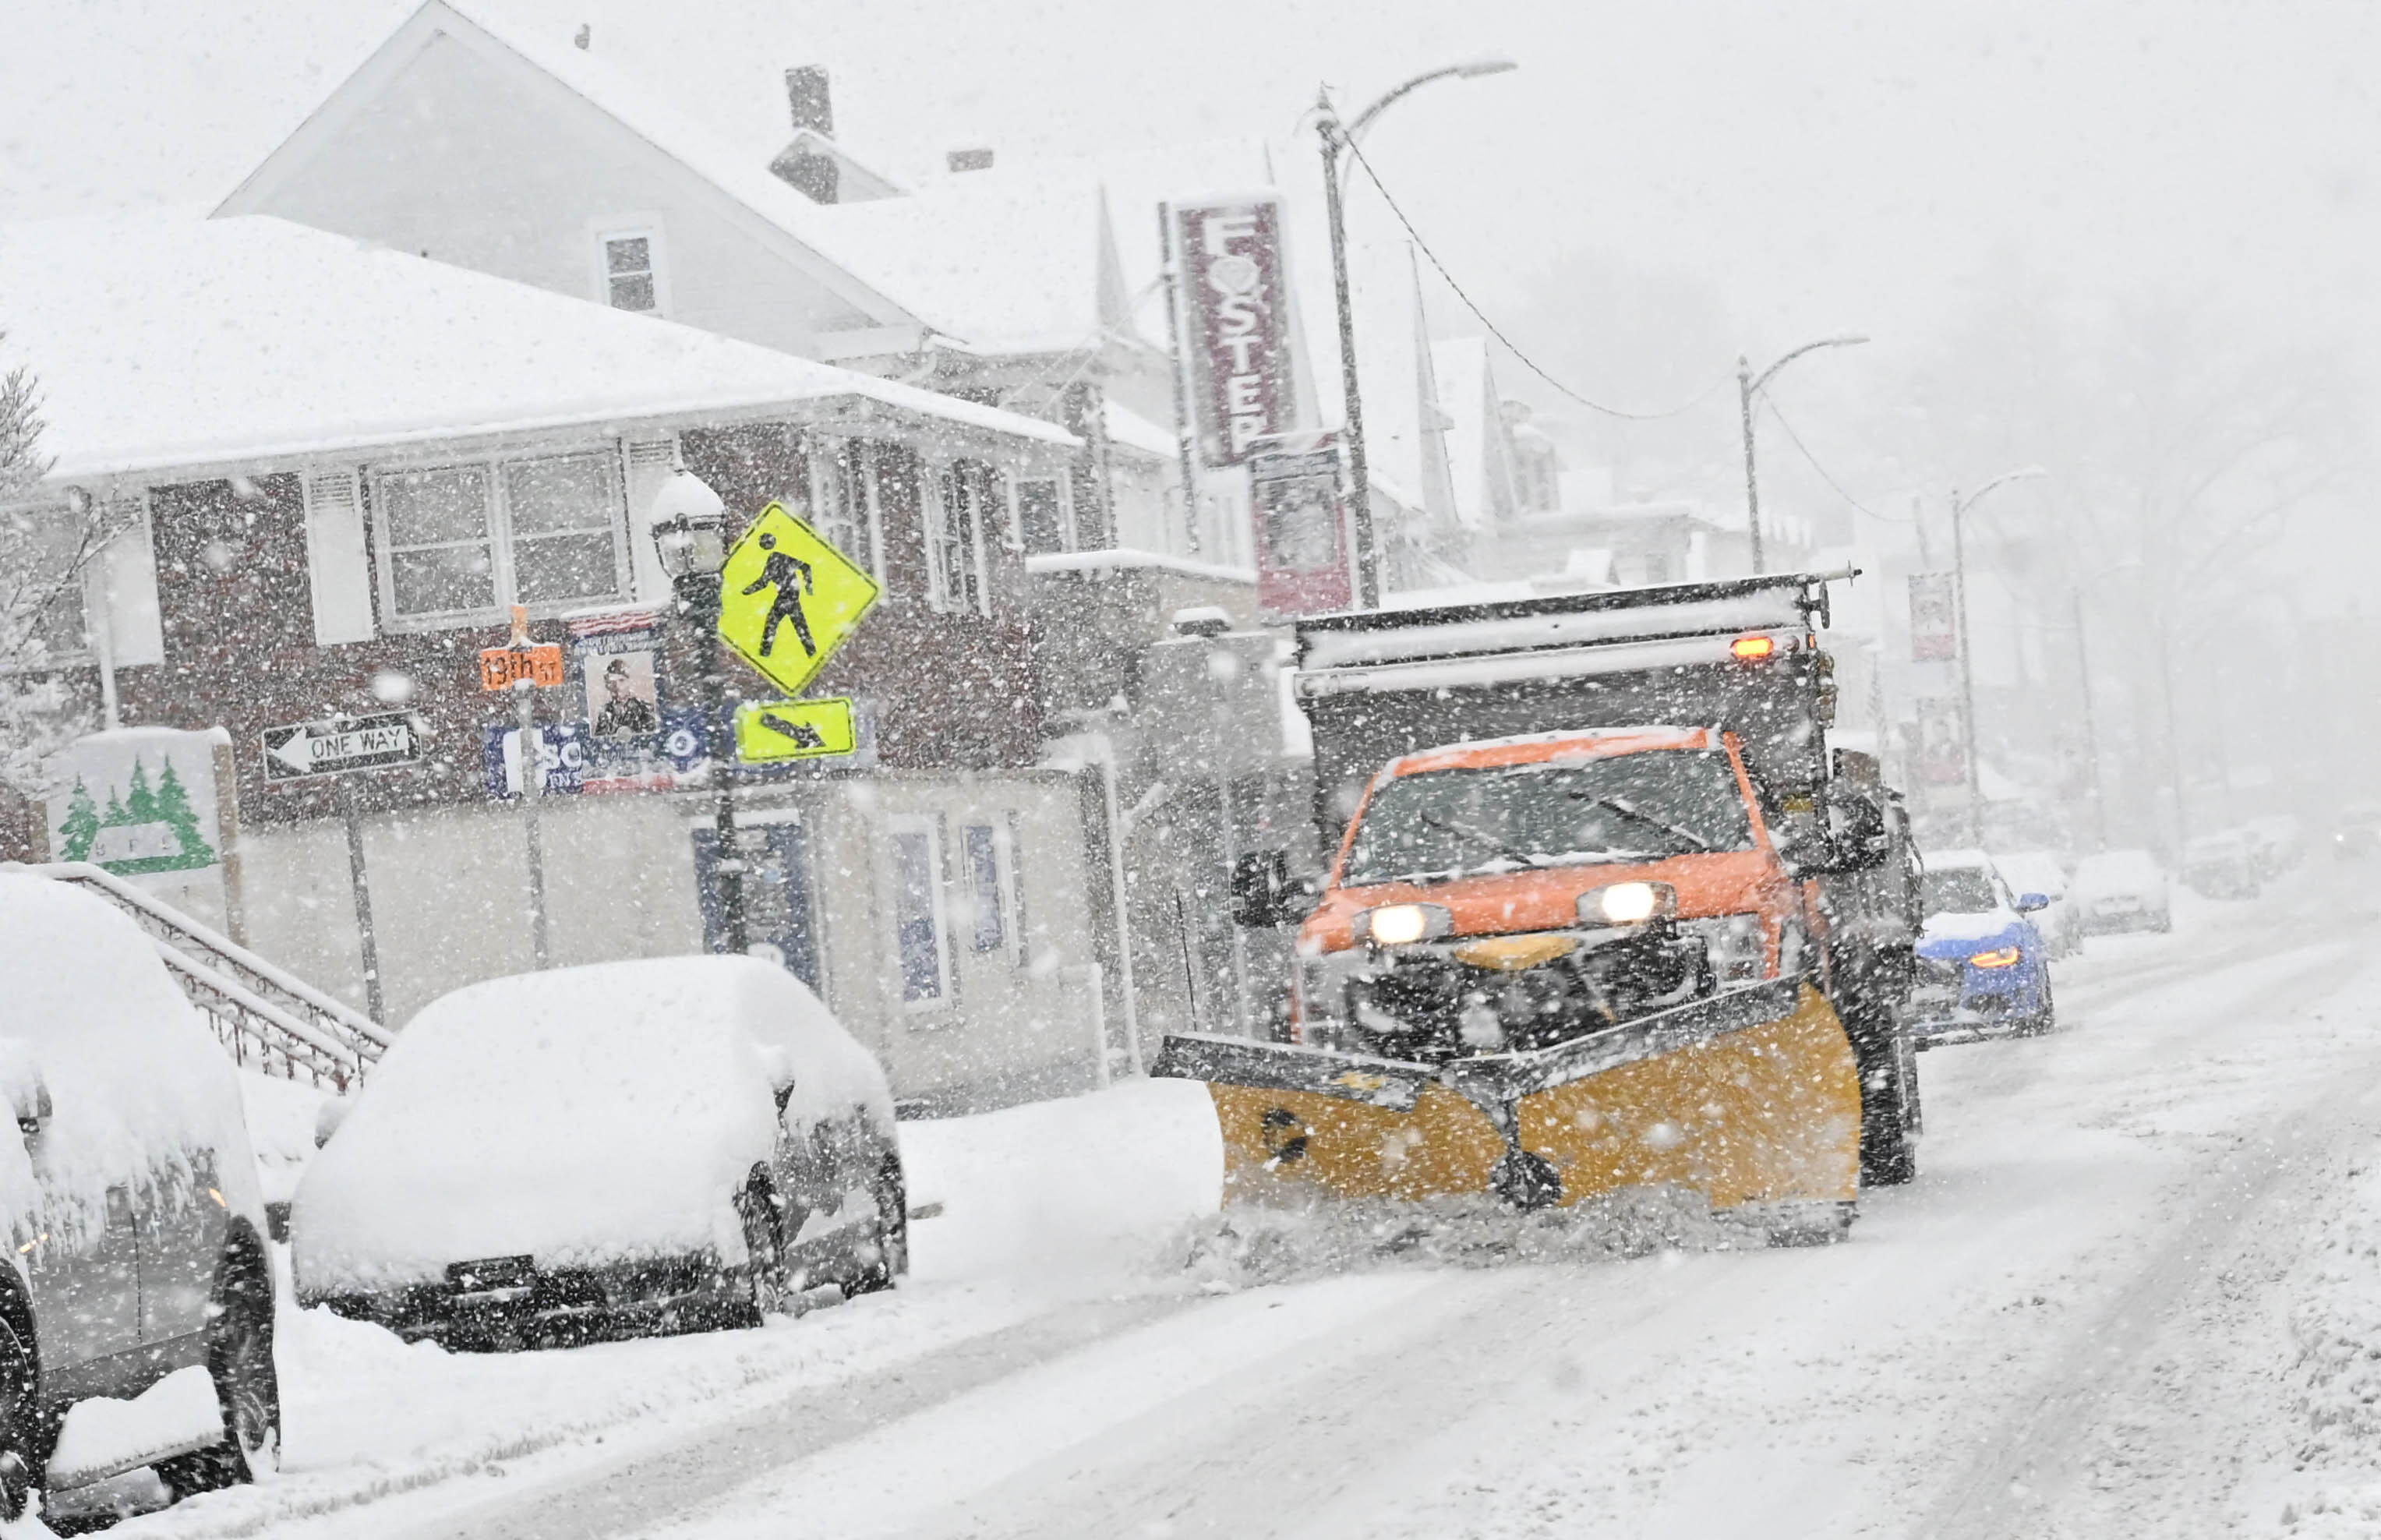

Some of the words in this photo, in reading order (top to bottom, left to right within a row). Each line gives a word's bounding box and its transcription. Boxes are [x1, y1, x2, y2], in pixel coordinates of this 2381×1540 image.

[486, 653, 534, 684] 19th
[312, 735, 352, 759] ONE
[359, 728, 401, 752] WAY
